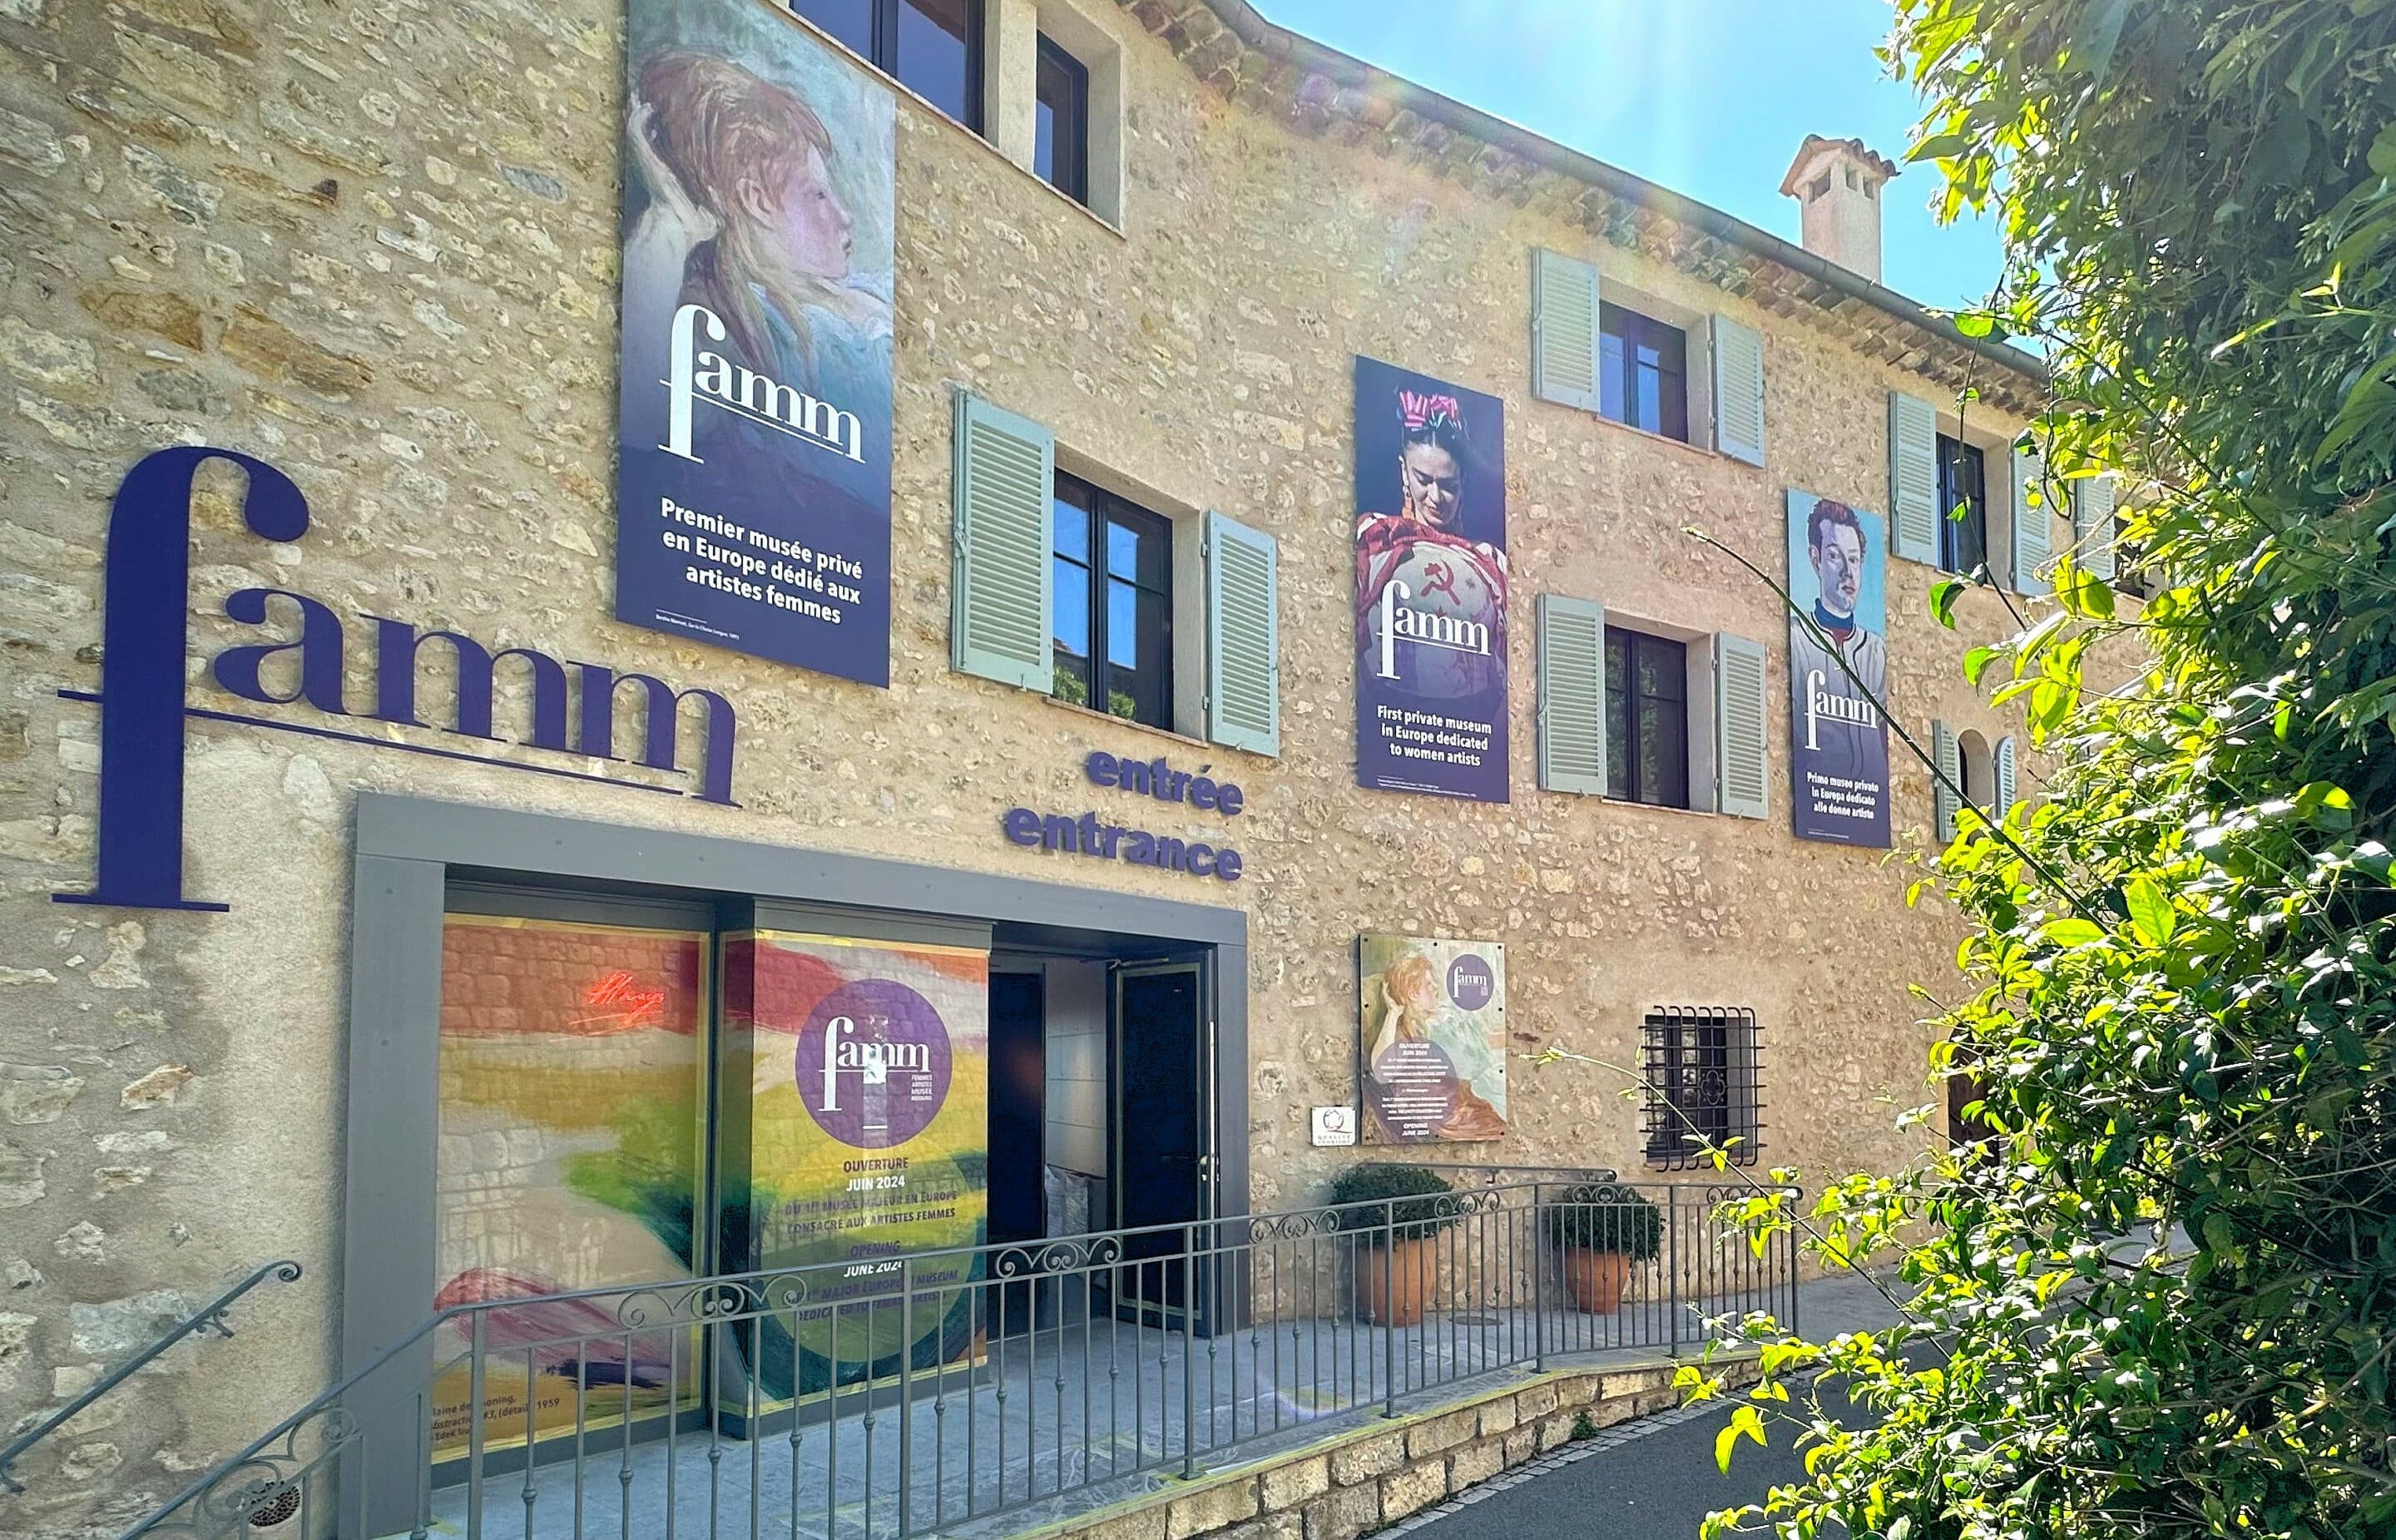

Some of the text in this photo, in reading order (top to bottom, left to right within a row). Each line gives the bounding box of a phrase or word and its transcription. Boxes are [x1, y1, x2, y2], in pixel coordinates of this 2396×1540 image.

[658, 304, 866, 463] famm
[661, 497, 863, 580] Premier musée privé
[662, 531, 862, 605] en Europe dédié aux
[686, 564, 842, 624] artistes femmes
[1376, 579, 1491, 679] famm
[52, 446, 743, 913] famm
[1377, 705, 1492, 735] First private museum
[1804, 669, 1879, 750] famm
[1381, 722, 1488, 750] in Europe dedicated
[1389, 743, 1481, 766] to women artists
[1085, 750, 1244, 816] entrée
[1807, 771, 1879, 793] Primo museo privato
[1814, 800, 1828, 813] alle
[1828, 802, 1851, 816] donne
[1820, 788, 1845, 804] Europa
[1846, 791, 1876, 806] dedicato
[1004, 807, 1244, 882] entrance
[1453, 966, 1487, 998] famm
[819, 1017, 931, 1112] famm
[844, 1157, 909, 1173] OUVERTURE
[846, 1175, 905, 1192] JUIN 2024
[905, 1191, 918, 1204] EN
[920, 1190, 957, 1202] EUROPE
[846, 1216, 869, 1229] AUX
[871, 1212, 913, 1225] ARTISTES
[916, 1208, 956, 1221] FEMMES
[850, 1240, 901, 1256] OPENING
[917, 1270, 958, 1285] MUSEUM
[432, 1405, 457, 1417] laine
[537, 1398, 560, 1410] 1959
